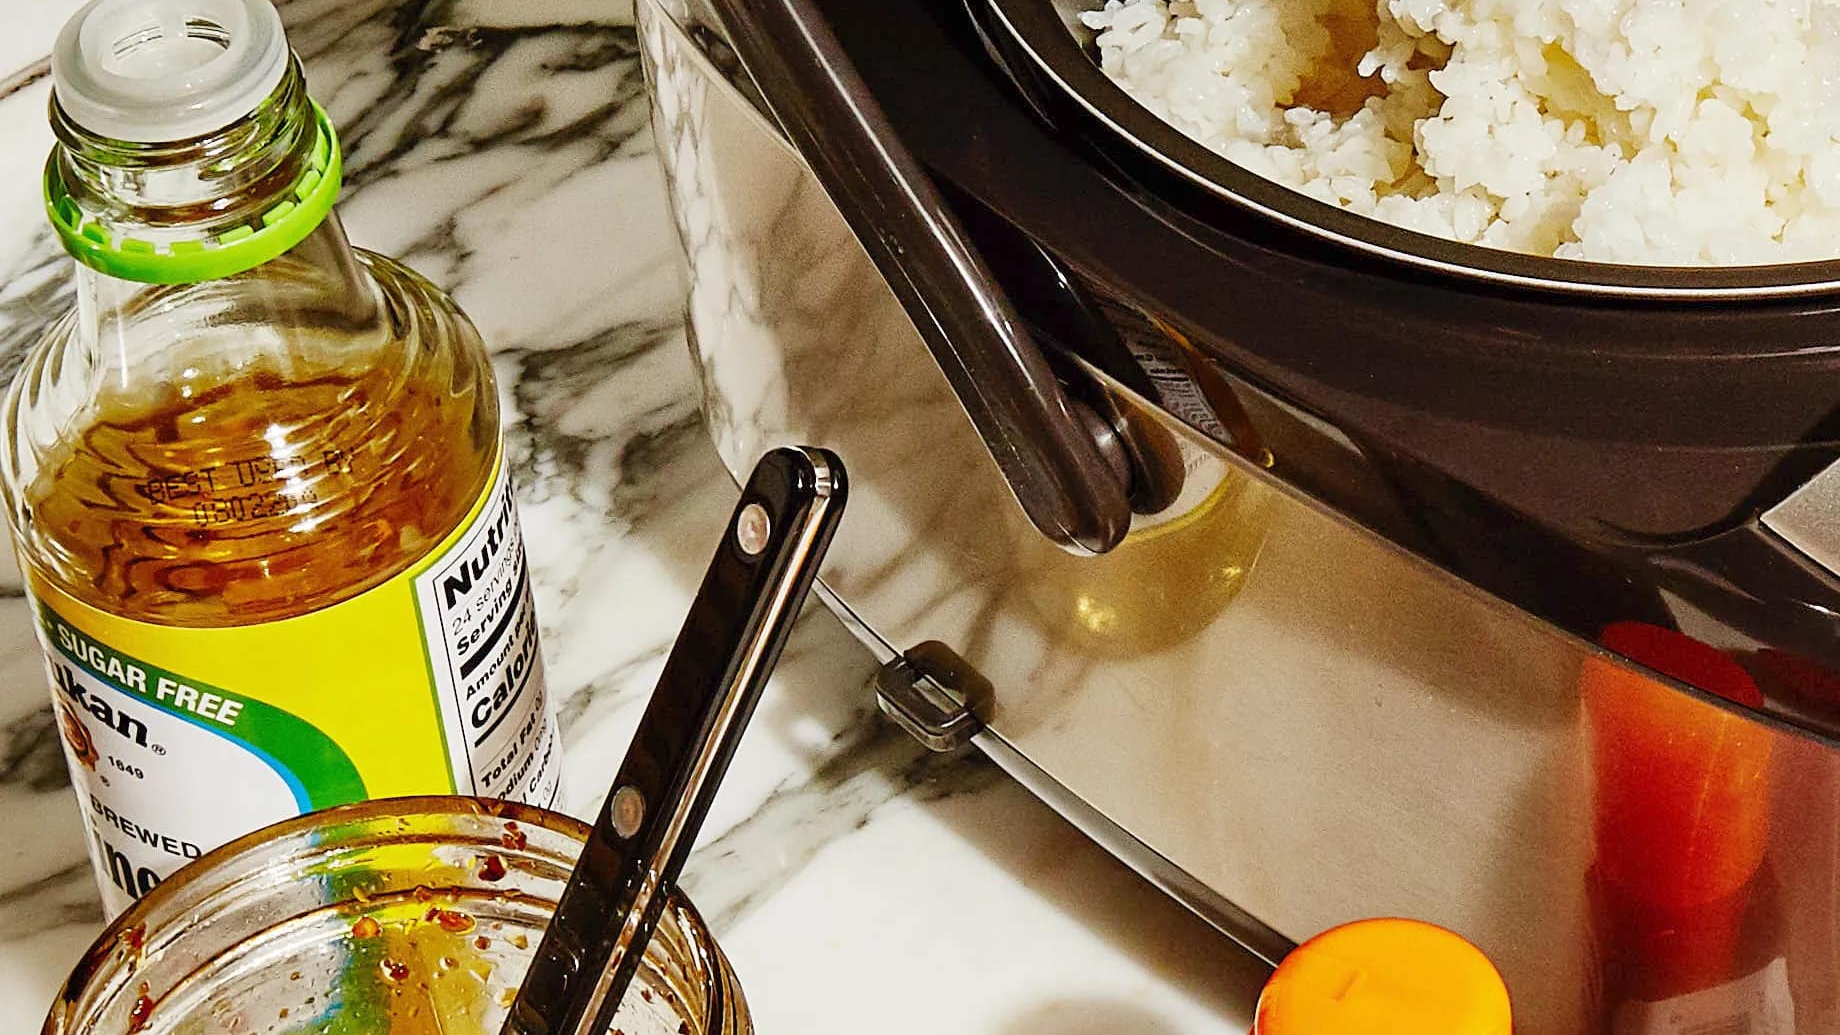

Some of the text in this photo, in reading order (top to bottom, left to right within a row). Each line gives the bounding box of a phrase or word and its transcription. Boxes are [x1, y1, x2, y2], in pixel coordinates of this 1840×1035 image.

[146, 466, 216, 506] BEST
[443, 468, 515, 610] Nutriti
[452, 607, 472, 636] 24
[455, 576, 512, 656] Serving
[57, 623, 245, 727] SUGAR FREE
[466, 634, 514, 702] Amount
[471, 610, 537, 729] Calori
[480, 712, 536, 789] Total Fat
[497, 752, 535, 802] odium
[89, 793, 202, 860] BREWED
